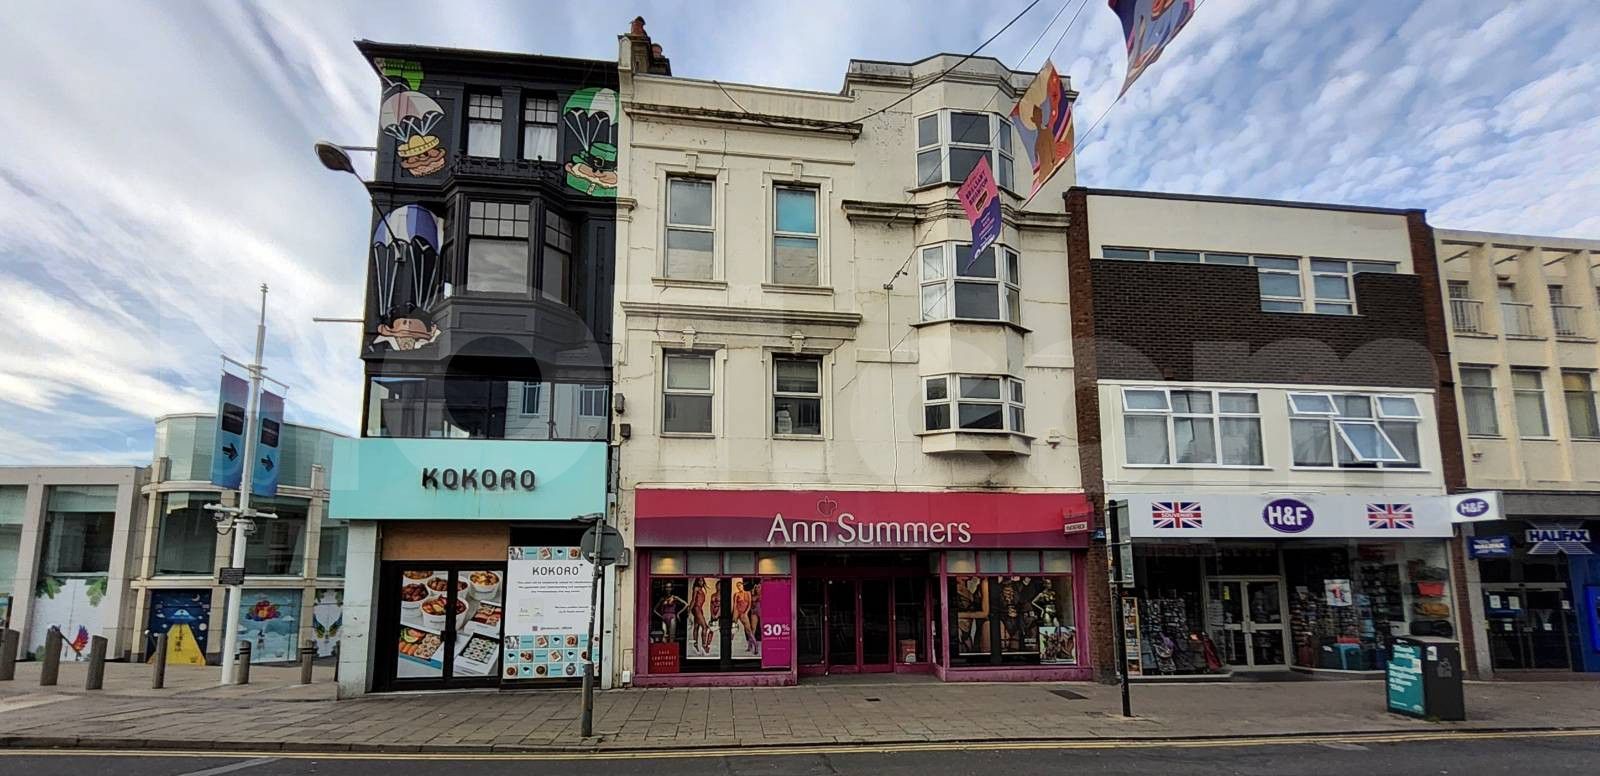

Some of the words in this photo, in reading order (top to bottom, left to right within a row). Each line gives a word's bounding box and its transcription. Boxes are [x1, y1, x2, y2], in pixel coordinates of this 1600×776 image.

[422, 467, 536, 491] KOKORO
[1460, 501, 1486, 513] H&F
[1268, 505, 1307, 526] H&F
[766, 513, 828, 542] Ann
[837, 513, 972, 543] Summers
[1528, 529, 1588, 541] HALIFAX
[532, 566, 579, 576] KOKORO
